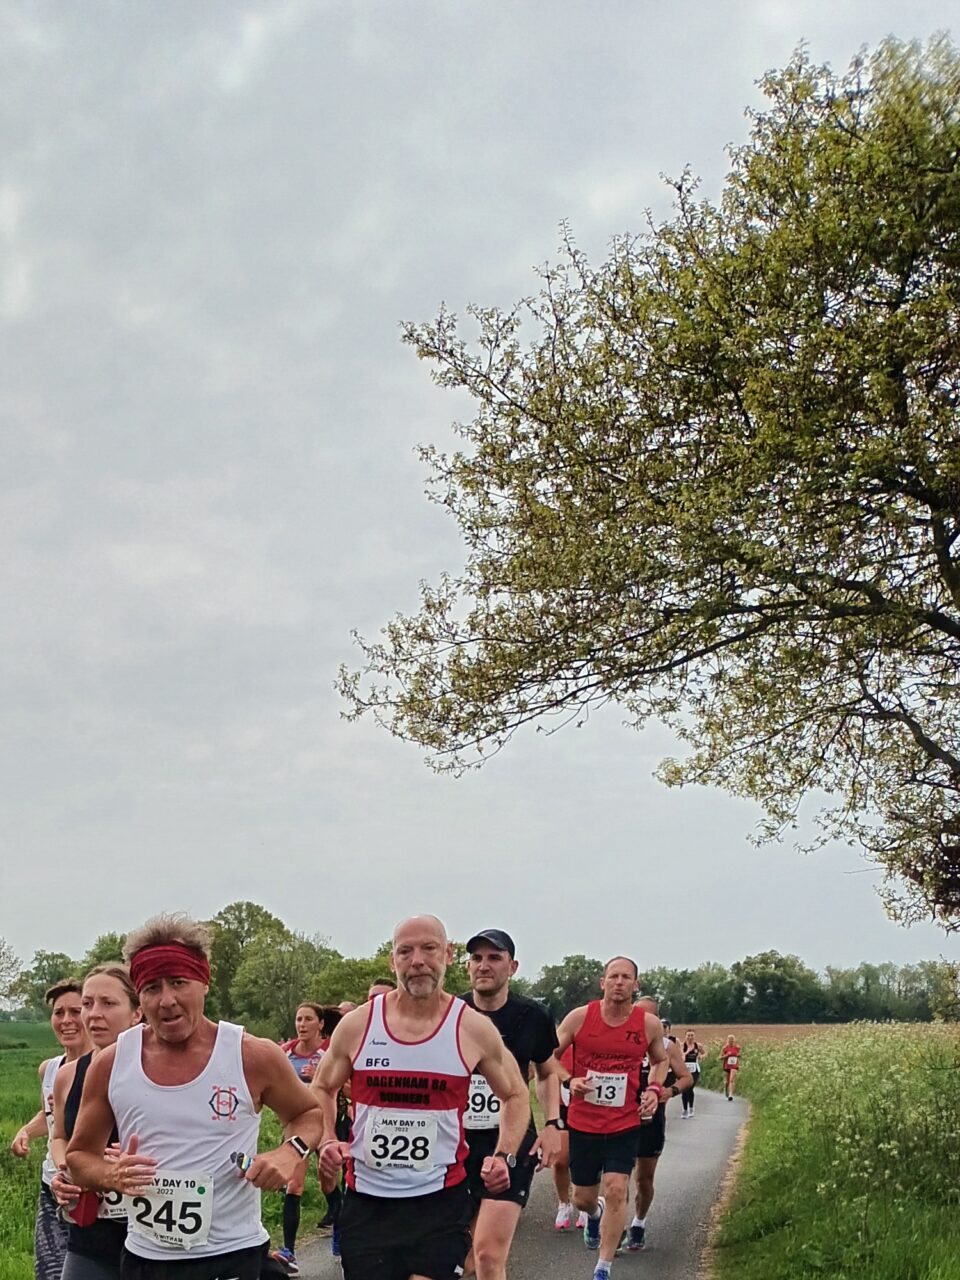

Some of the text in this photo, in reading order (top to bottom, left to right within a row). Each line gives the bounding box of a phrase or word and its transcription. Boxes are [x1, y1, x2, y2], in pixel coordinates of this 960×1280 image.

[366, 1058, 390, 1067] BFG
[366, 1076, 429, 1089] DAGENHAM
[595, 1085, 616, 1100] 13
[382, 1119, 398, 1127] MAY
[371, 1134, 429, 1161] 328
[163, 1179, 181, 1188] DAY
[185, 1180, 196, 1189] 10
[132, 1196, 202, 1235] 245
